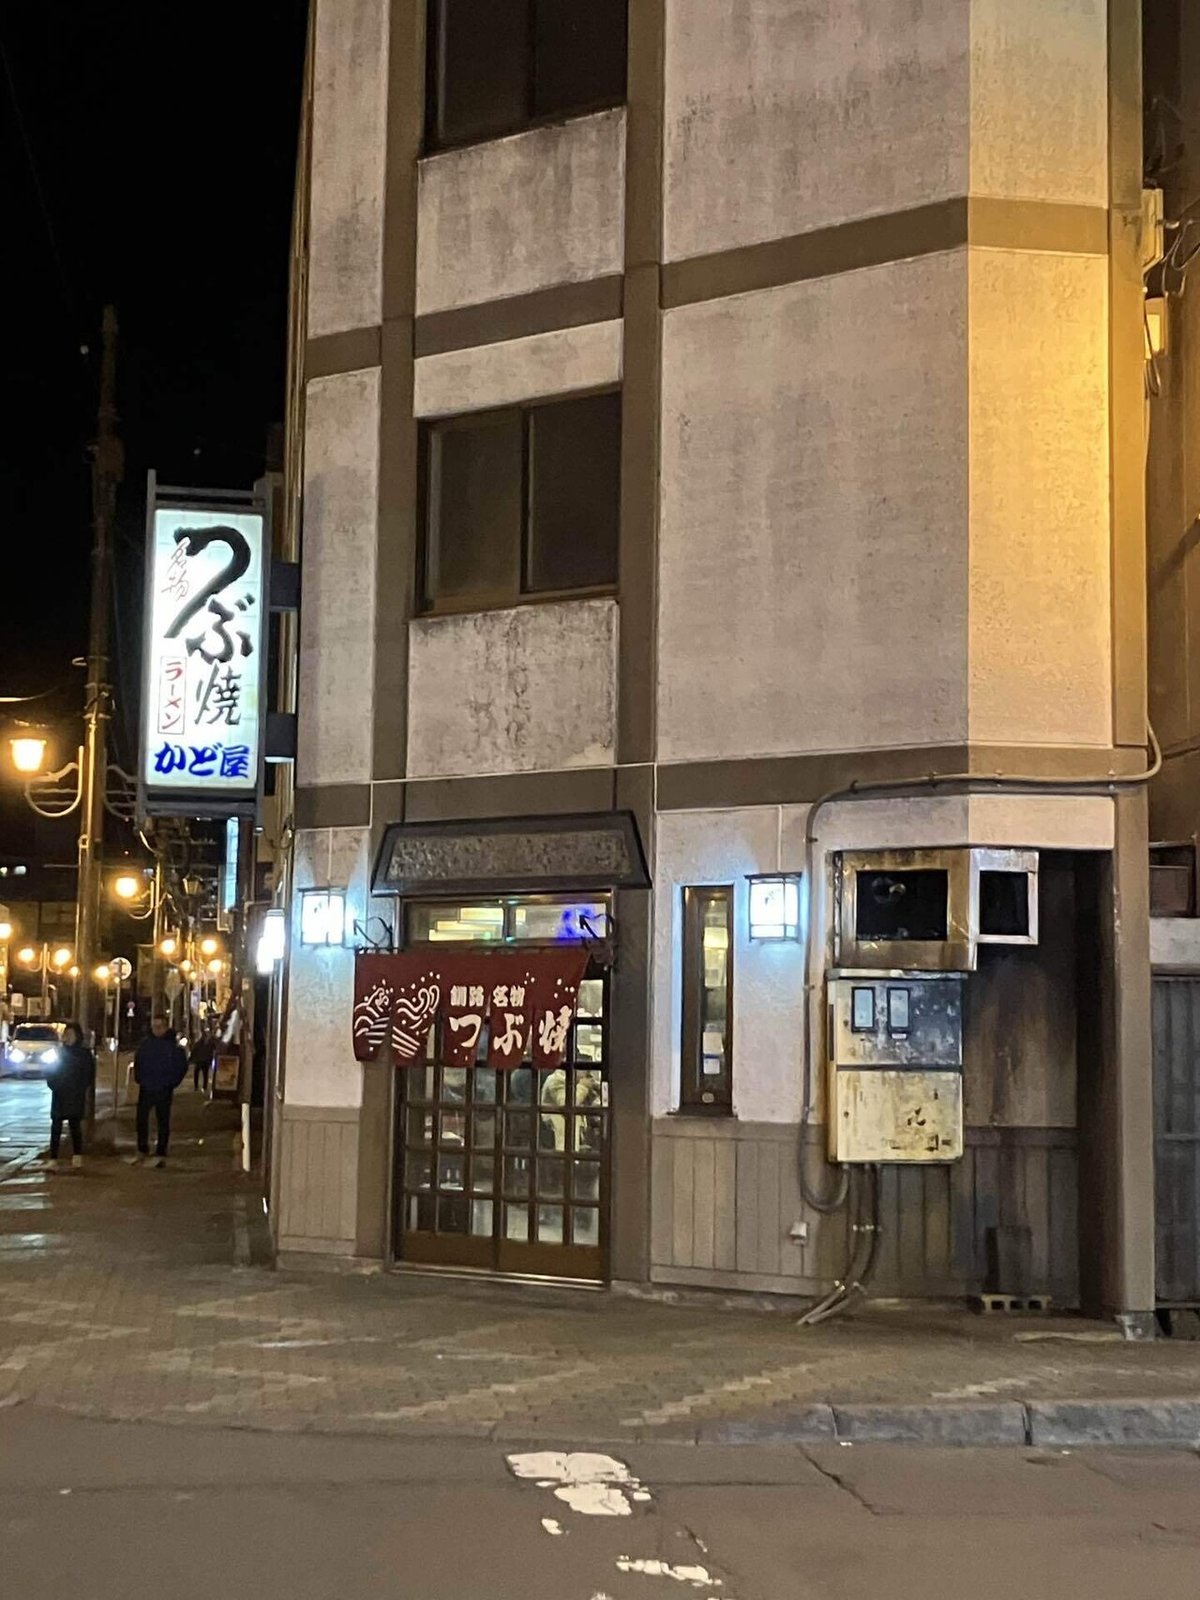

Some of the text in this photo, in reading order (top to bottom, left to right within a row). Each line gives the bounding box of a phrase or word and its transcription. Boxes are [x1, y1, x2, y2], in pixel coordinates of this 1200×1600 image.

[164, 525, 256, 725] つぶ焼
[160, 661, 183, 730] ラーメン
[154, 741, 250, 778] かど屋
